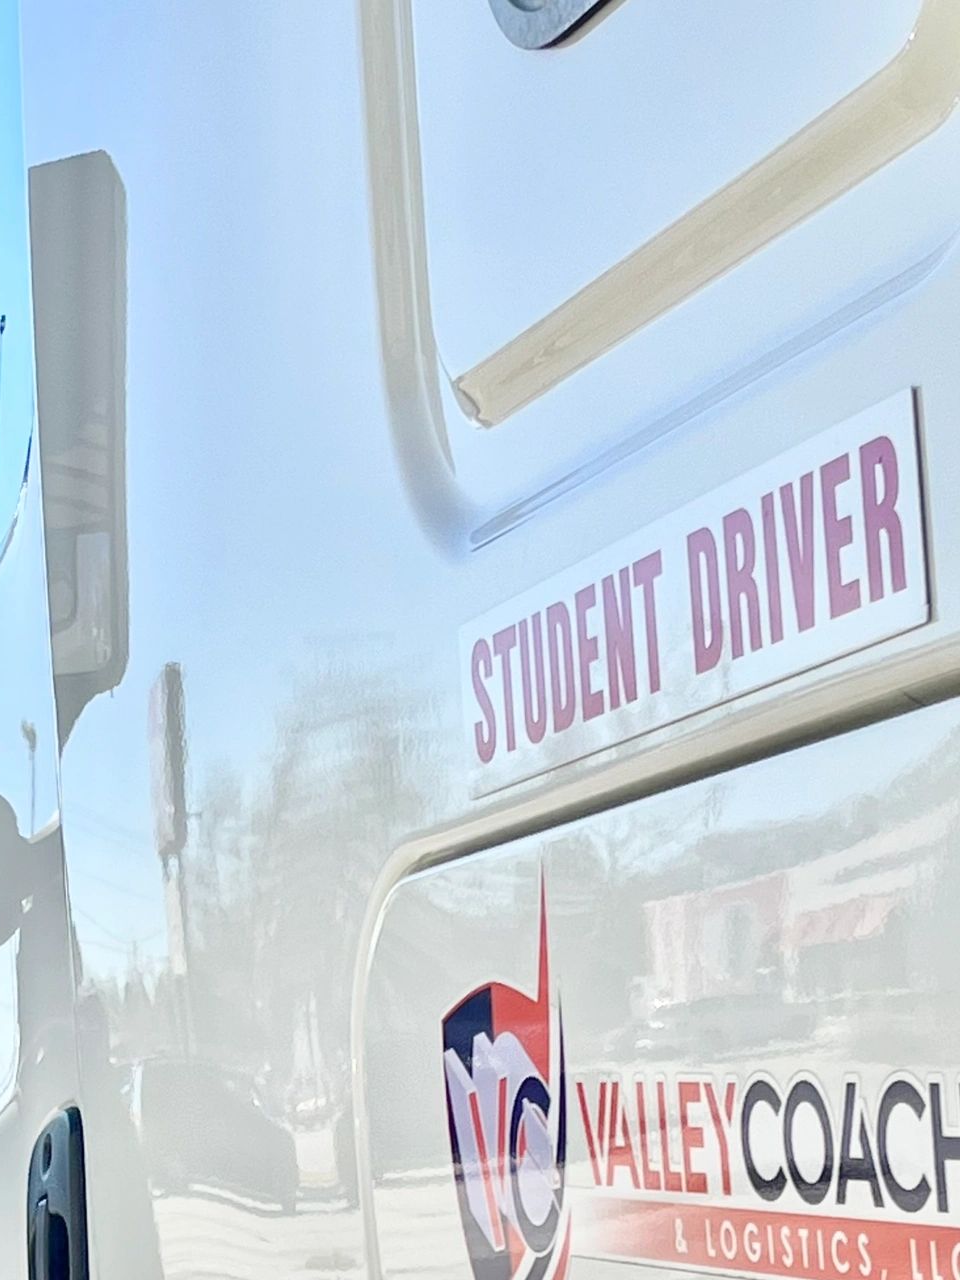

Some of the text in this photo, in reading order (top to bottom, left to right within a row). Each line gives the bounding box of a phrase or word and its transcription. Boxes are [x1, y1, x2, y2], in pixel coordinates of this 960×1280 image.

[470, 435, 907, 764] STUDENT DRIVER
[675, 1217, 688, 1254] &
